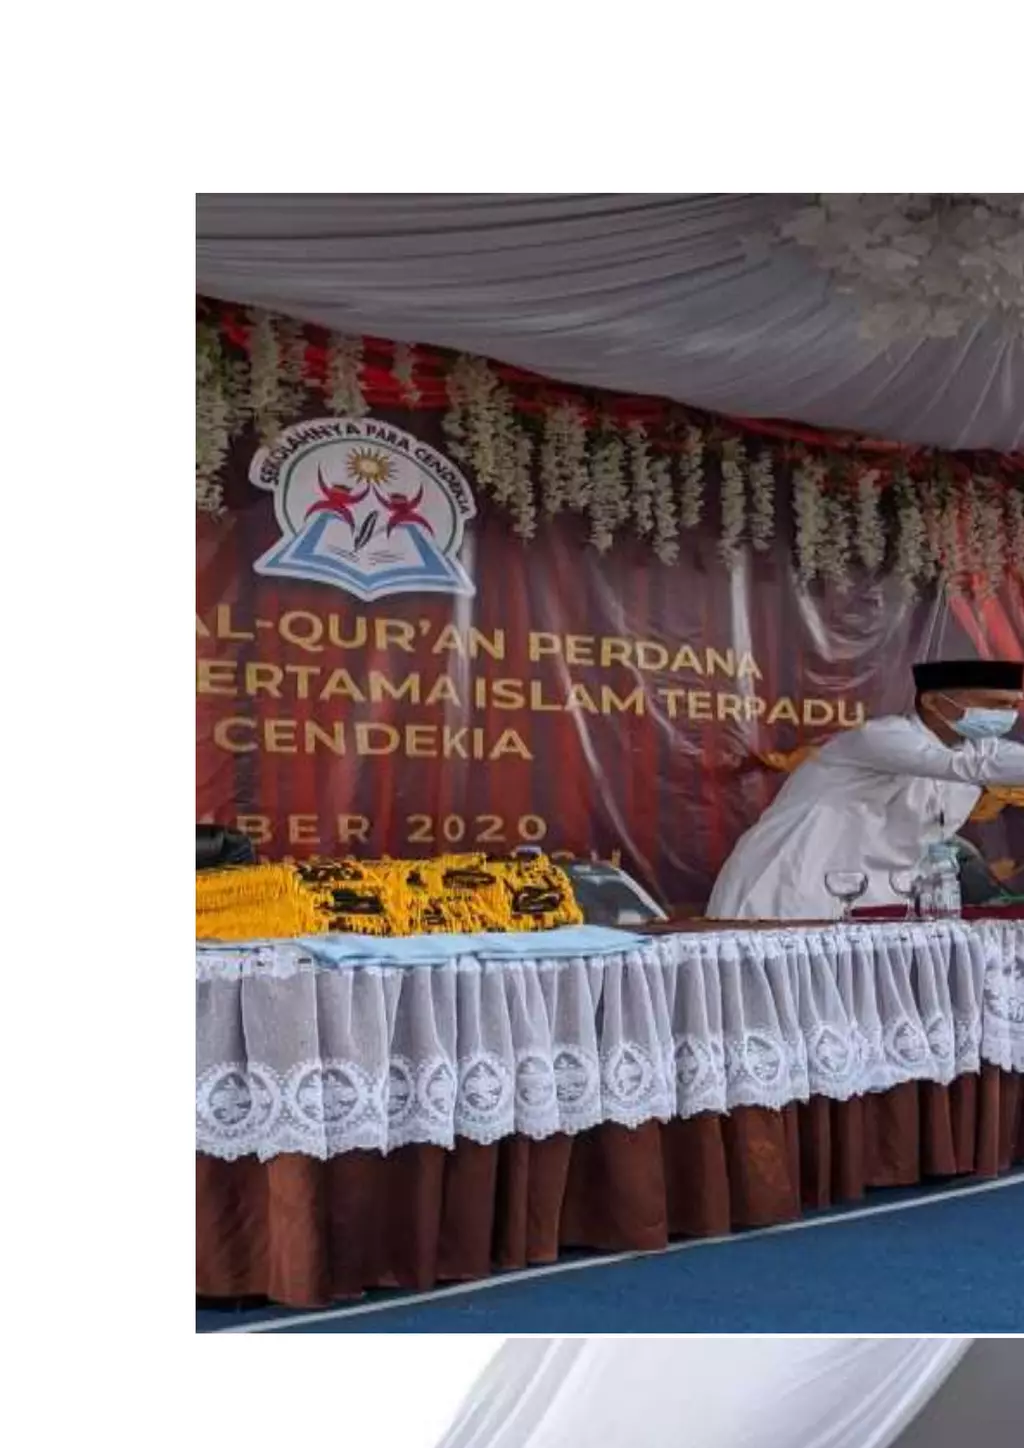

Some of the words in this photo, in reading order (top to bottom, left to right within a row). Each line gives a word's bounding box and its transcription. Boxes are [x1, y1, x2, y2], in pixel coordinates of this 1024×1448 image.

[366, 423, 409, 452] PARA
[415, 448, 470, 515] CENDEKIA
[529, 632, 763, 680] PERDANA
[196, 659, 461, 707] ERTAMA
[475, 676, 645, 717] ISLAM
[658, 688, 866, 728] TERPADU
[213, 716, 533, 761] CENDEKIA
[200, 812, 371, 844] BER
[406, 813, 547, 843] 2020
